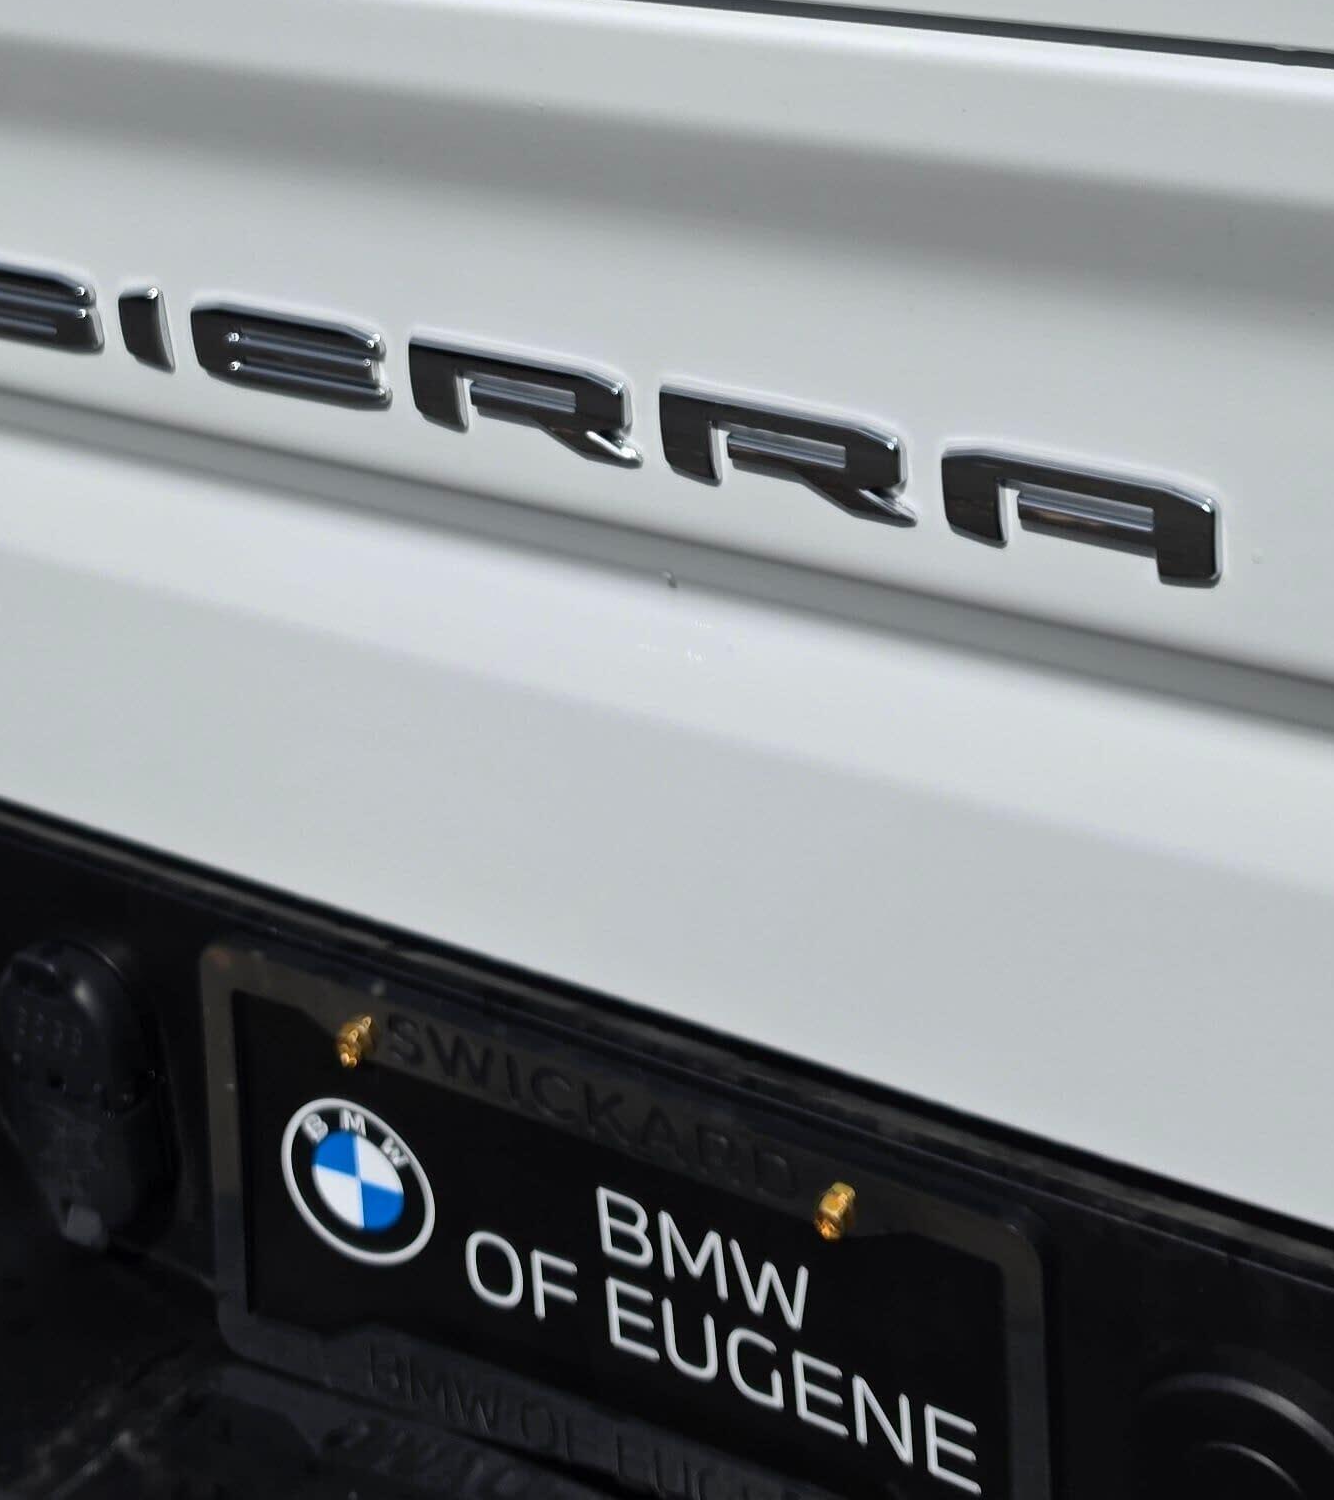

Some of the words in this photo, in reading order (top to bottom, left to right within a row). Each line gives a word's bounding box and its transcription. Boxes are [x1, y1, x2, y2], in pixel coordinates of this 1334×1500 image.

[301, 1108, 411, 1169] BMW
[385, 1013, 798, 1199] SWICKARD
[596, 1186, 809, 1330] BMW
[466, 1231, 578, 1320] OF
[606, 1276, 982, 1495] EUGENE
